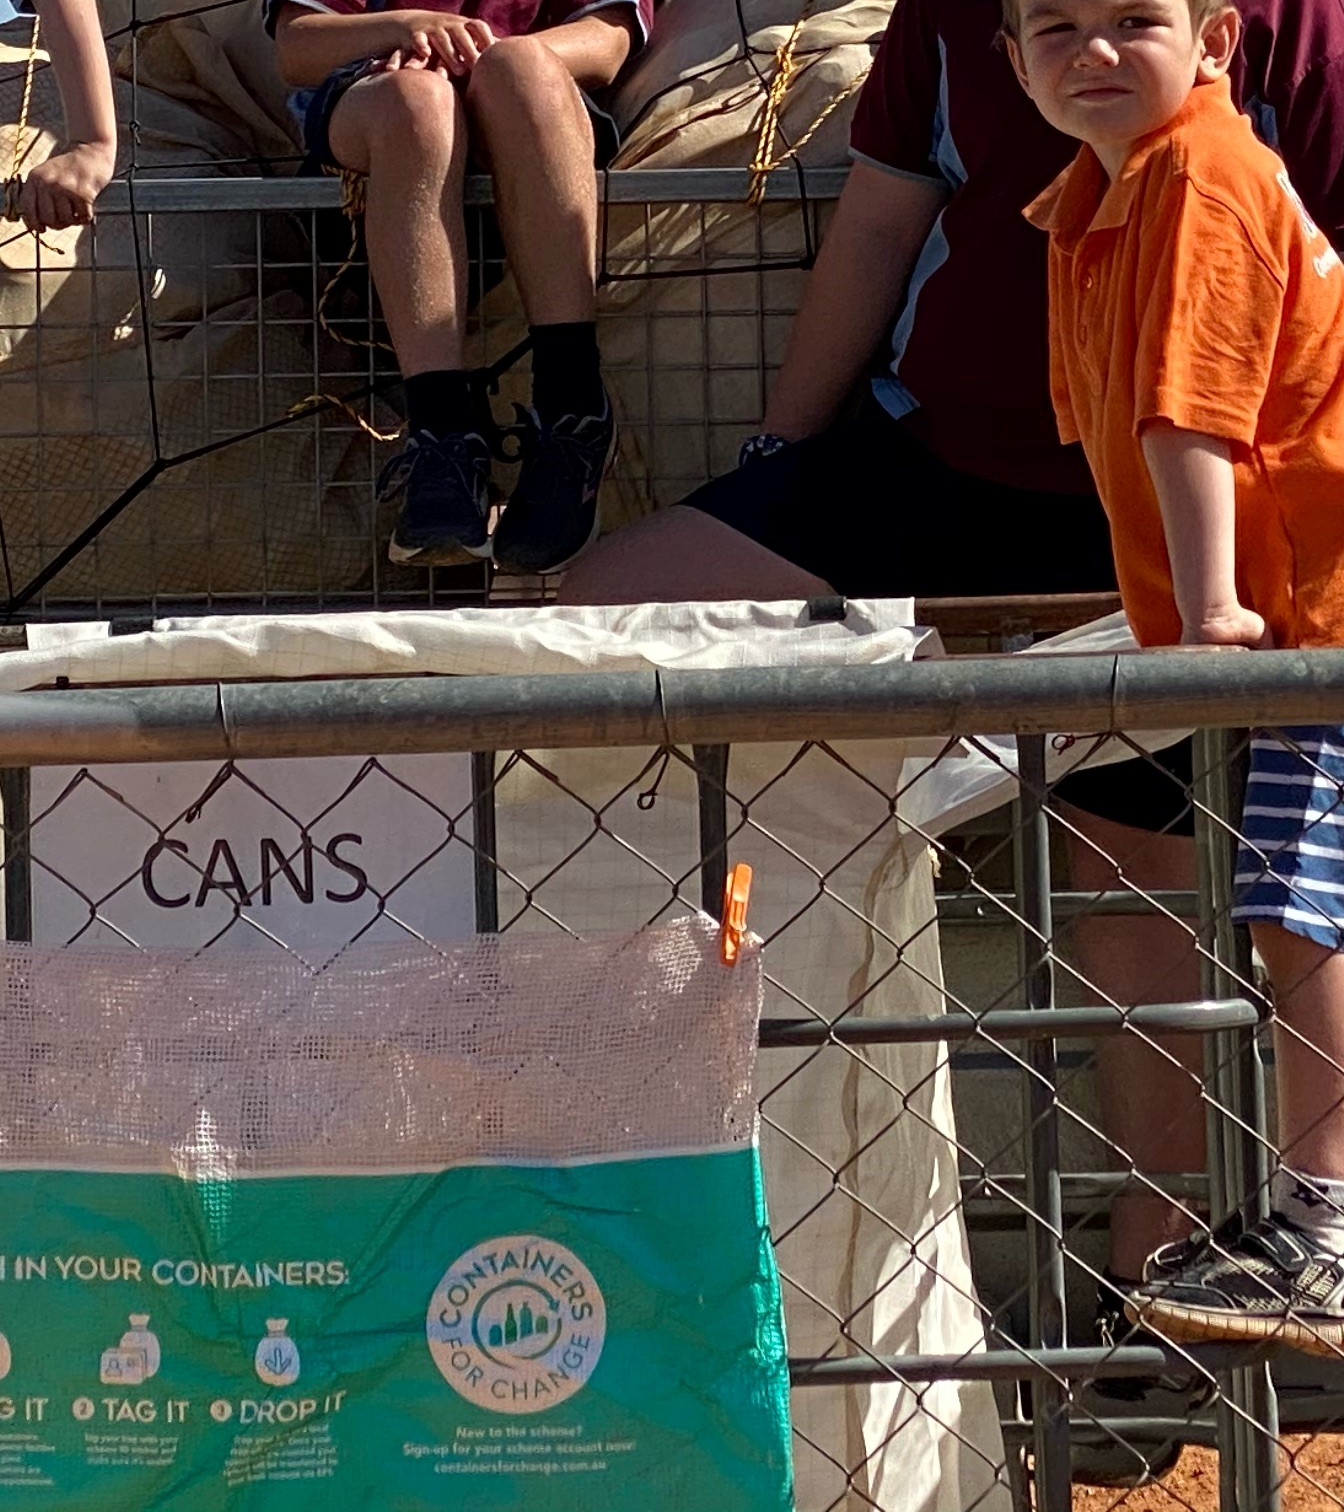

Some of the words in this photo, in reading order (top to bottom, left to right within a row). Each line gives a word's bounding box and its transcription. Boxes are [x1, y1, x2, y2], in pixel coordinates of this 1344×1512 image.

[141, 833, 368, 908] CANS
[14, 1255, 47, 1281] IN
[54, 1255, 142, 1282] YOUR
[439, 1247, 594, 1327] CONTAINERS
[442, 1337, 484, 1388] FOR
[491, 1333, 590, 1400] CHANGE
[25, 1396, 49, 1421] IT
[101, 1398, 157, 1423] TAG
[167, 1399, 190, 1423] IT
[240, 1399, 316, 1424] DROP
[324, 1389, 347, 1413] IT
[456, 1426, 485, 1439] New
[489, 1427, 503, 1438] to
[453, 1442, 471, 1455] for
